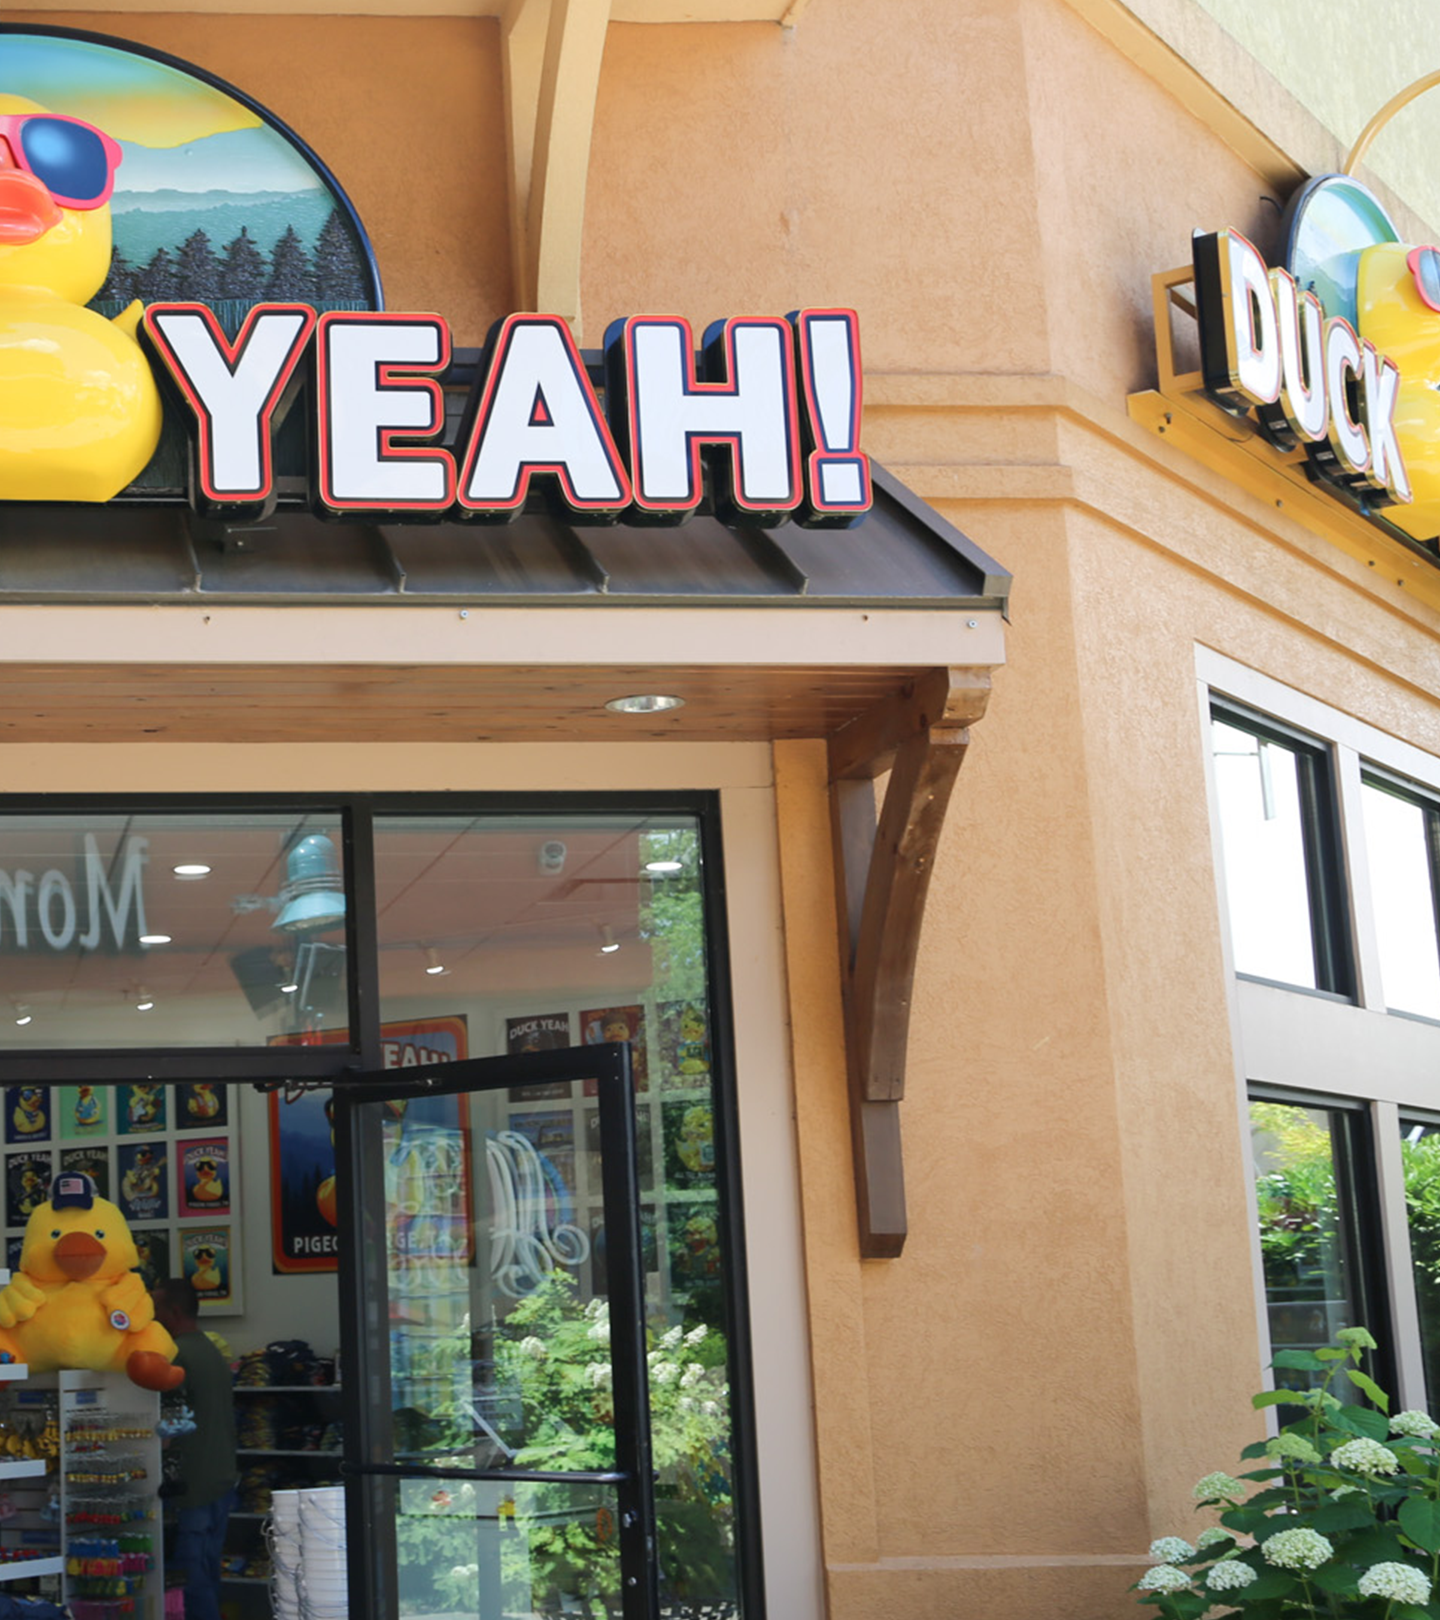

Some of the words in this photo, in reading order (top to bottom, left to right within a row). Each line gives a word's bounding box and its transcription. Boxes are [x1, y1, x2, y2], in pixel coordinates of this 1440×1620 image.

[144, 302, 873, 512] YEAH!
[1224, 225, 1413, 504] DUCK
[509, 1020, 539, 1040] DUCK
